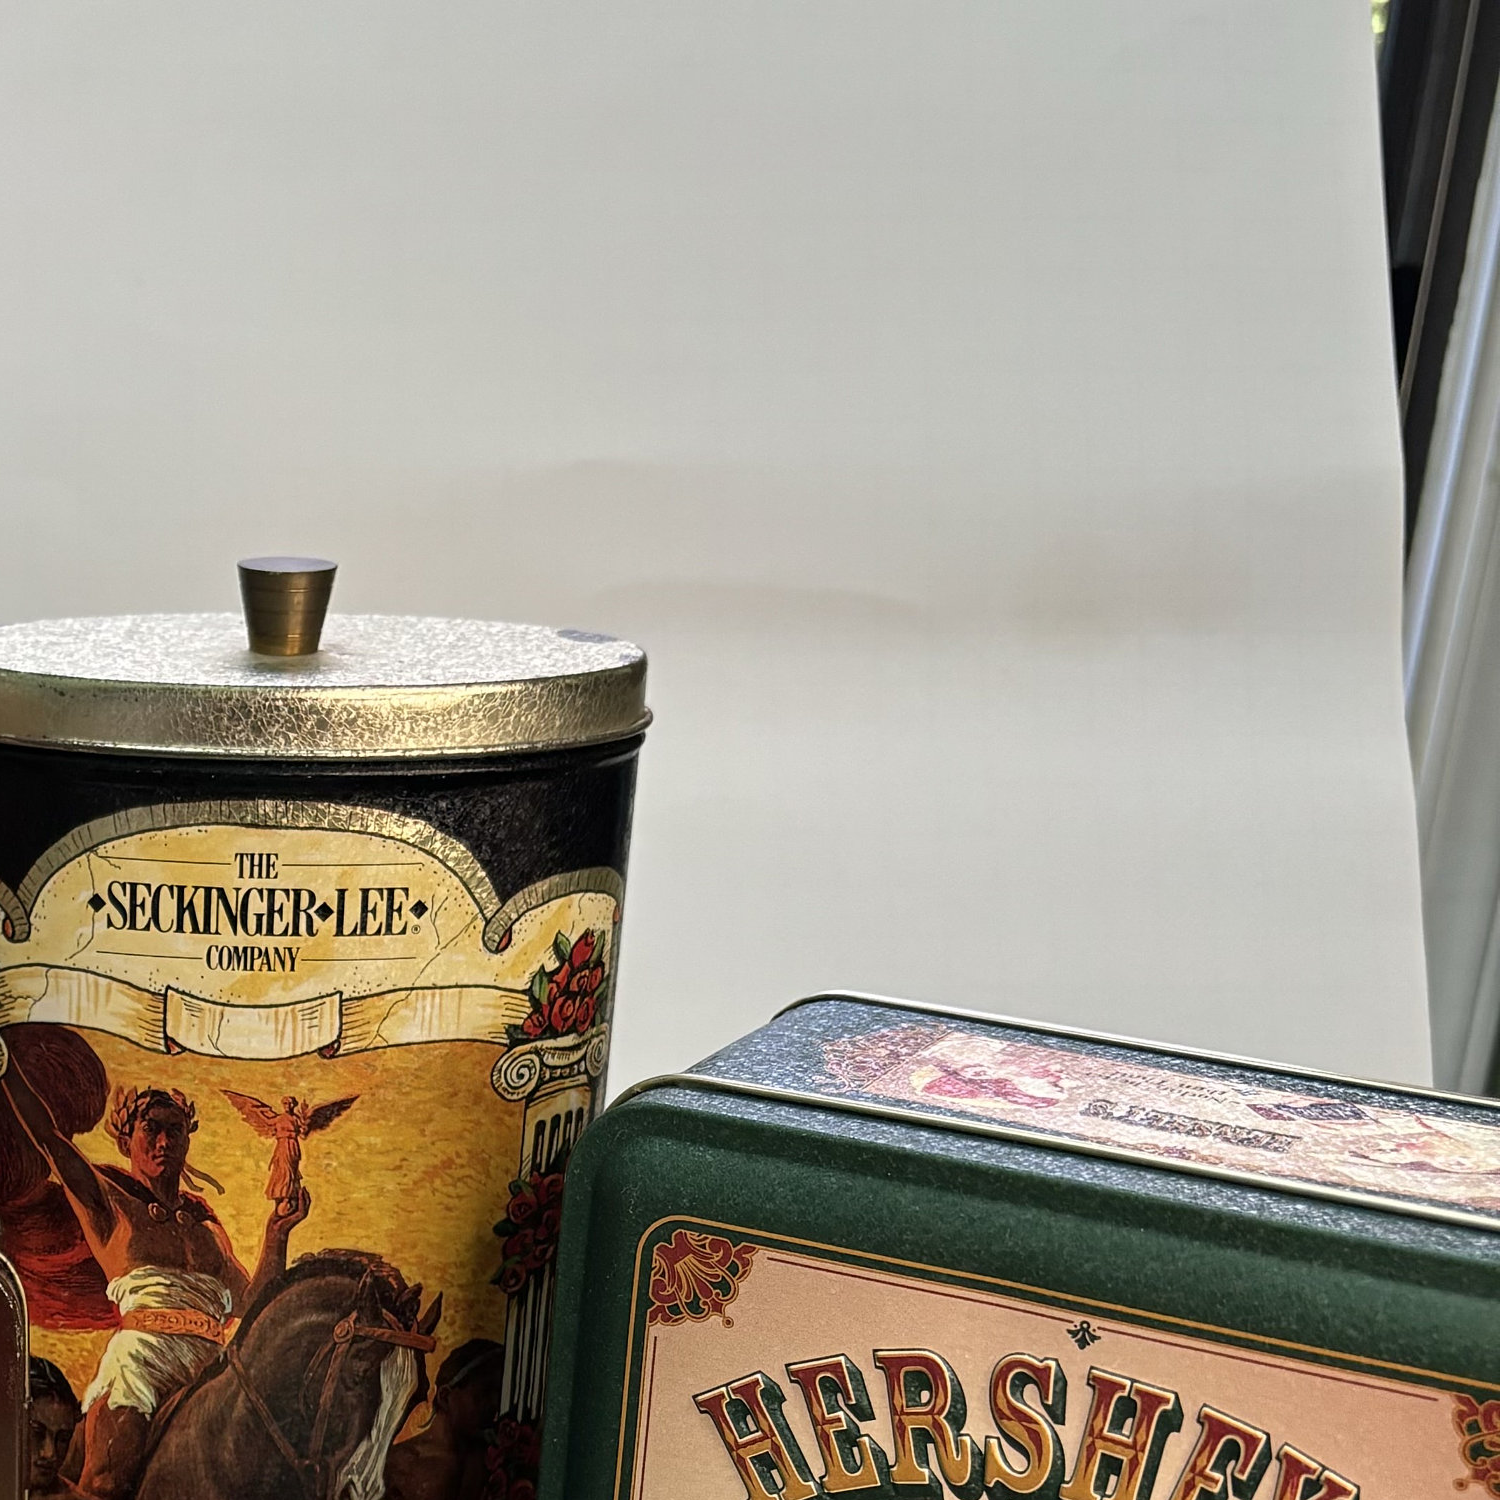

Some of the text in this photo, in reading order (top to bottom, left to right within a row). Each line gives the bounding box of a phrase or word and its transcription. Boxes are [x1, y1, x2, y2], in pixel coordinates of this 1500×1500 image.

[233, 852, 280, 880] THE
[105, 881, 412, 938] SECKINGER LEE
[205, 944, 301, 973] COMPANY
